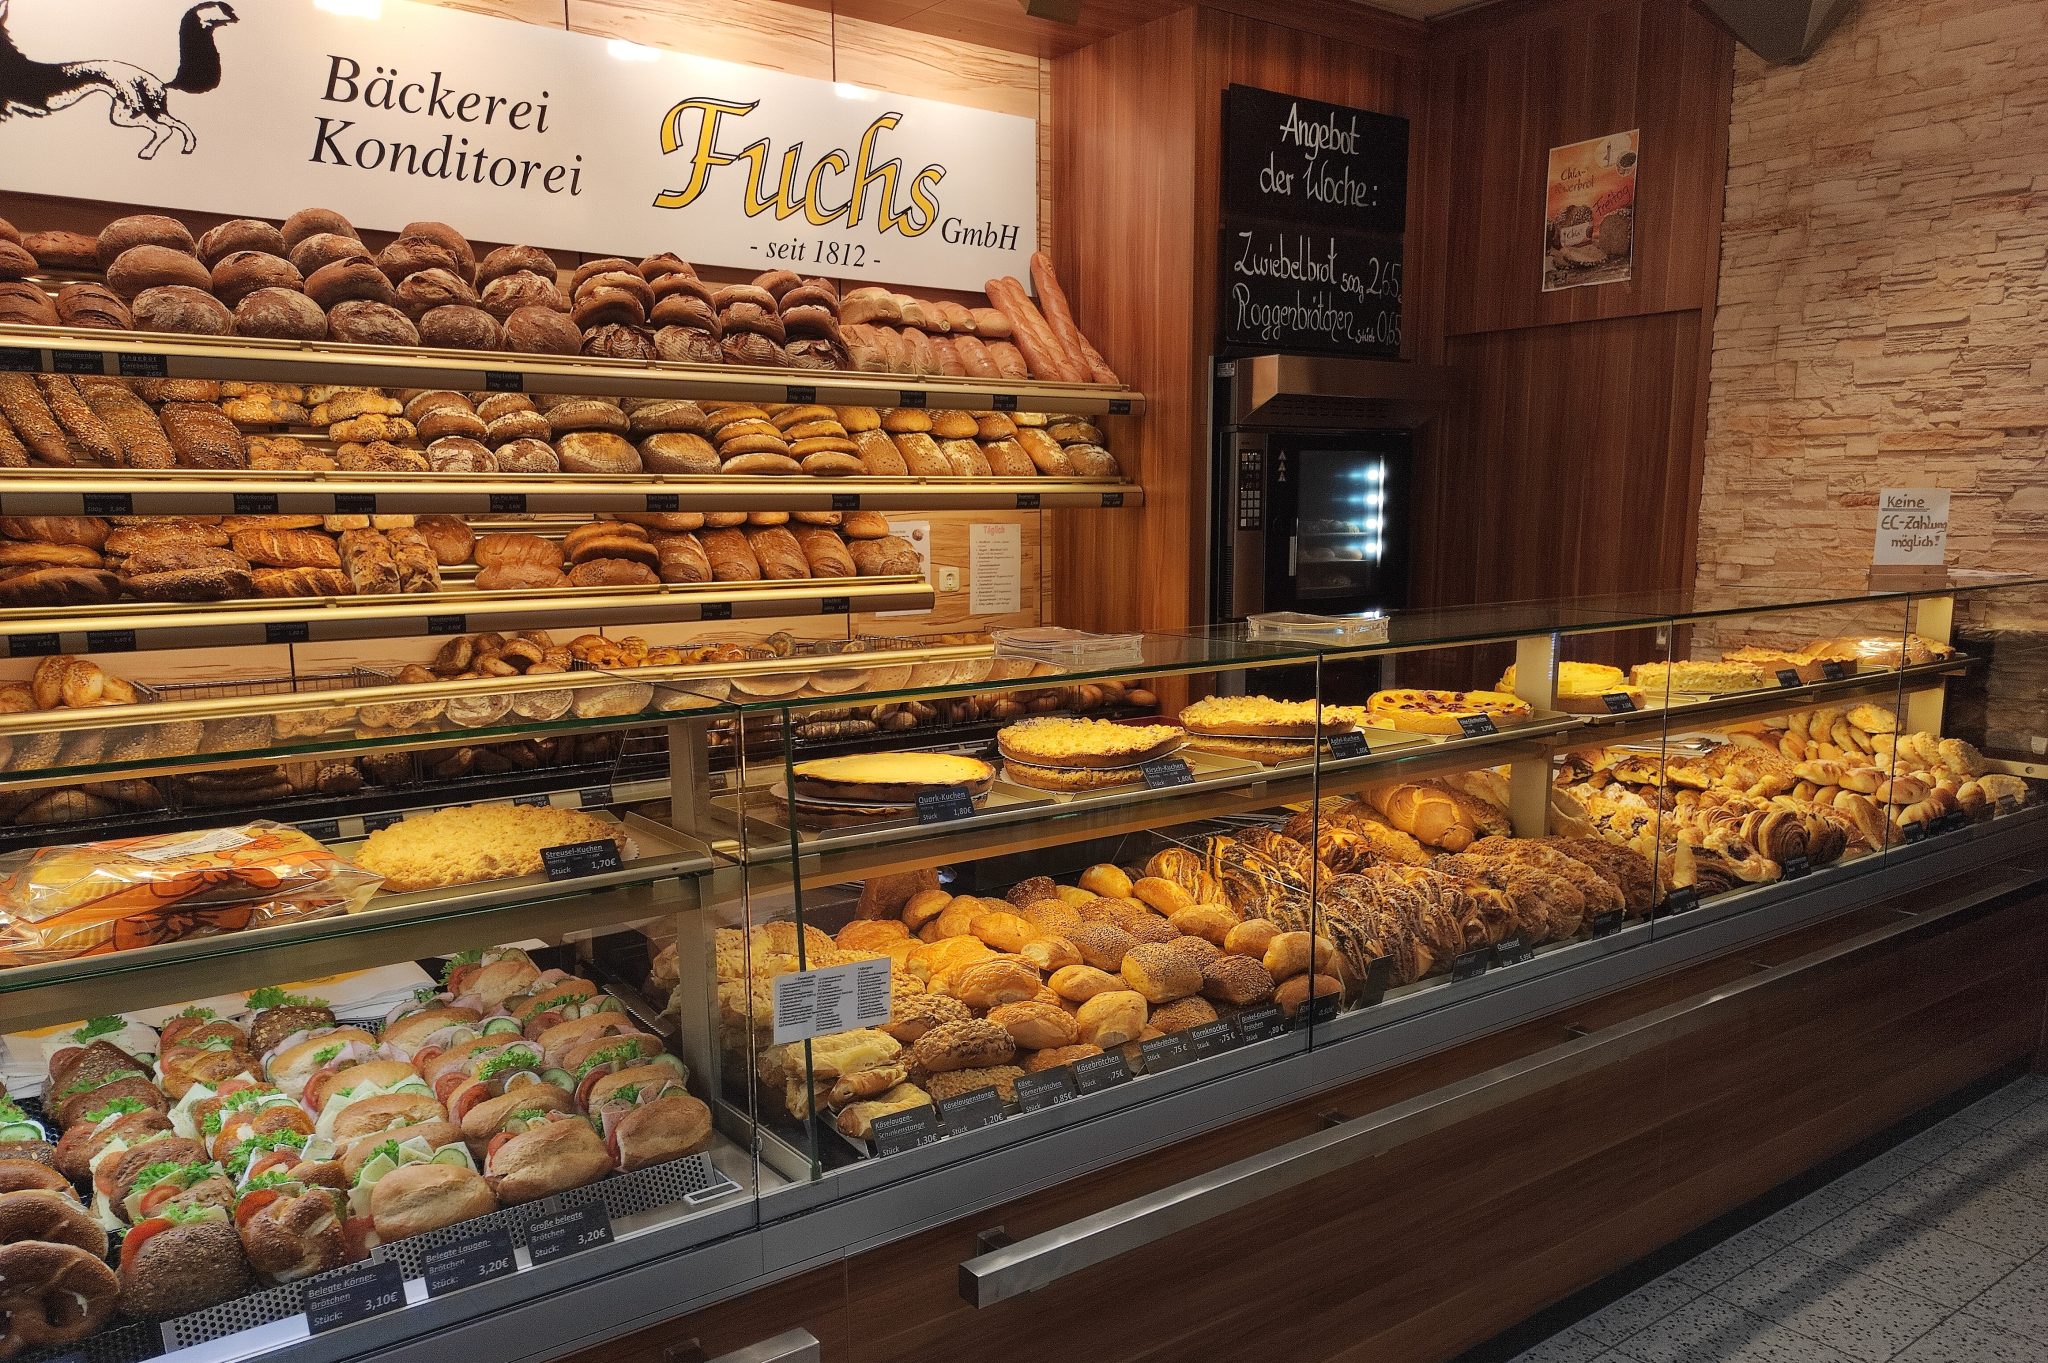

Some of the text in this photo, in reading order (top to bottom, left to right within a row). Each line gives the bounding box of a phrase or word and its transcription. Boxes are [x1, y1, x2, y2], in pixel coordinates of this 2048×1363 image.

[320, 54, 549, 133] Bäckerei
[1280, 102, 1361, 161] Angebot
[308, 116, 582, 196] Konditorei
[652, 97, 947, 237] Fuchs
[1259, 151, 1294, 196] der
[941, 217, 1021, 251] GmbH
[766, 238, 805, 262] seit
[813, 239, 866, 267] 1812
[1234, 231, 1338, 285] Zwiebelbrot
[1887, 494, 1925, 508] Keine
[1881, 514, 1947, 534] EC-Zahlung
[918, 791, 967, 805] Quark-Kuchen
[545, 844, 604, 858] Streusel-Kuchen
[591, 857, 617, 870] 1,70€
[1076, 1055, 1120, 1073] Käsebrötchen
[983, 1112, 1004, 1126] 1,20€
[916, 1133, 938, 1147] 1,30€
[530, 1211, 584, 1232] Große belegte
[531, 1227, 566, 1243] Brötchen
[578, 1227, 606, 1245] 3,20€
[426, 1240, 492, 1263] Belegte Laugen-
[429, 1258, 466, 1275] Brötchen
[478, 1257, 510, 1276] 3,20€
[308, 1272, 377, 1299] Belegte Körner-
[311, 1292, 351, 1311] Brötchen
[364, 1290, 399, 1311] 3,10€
